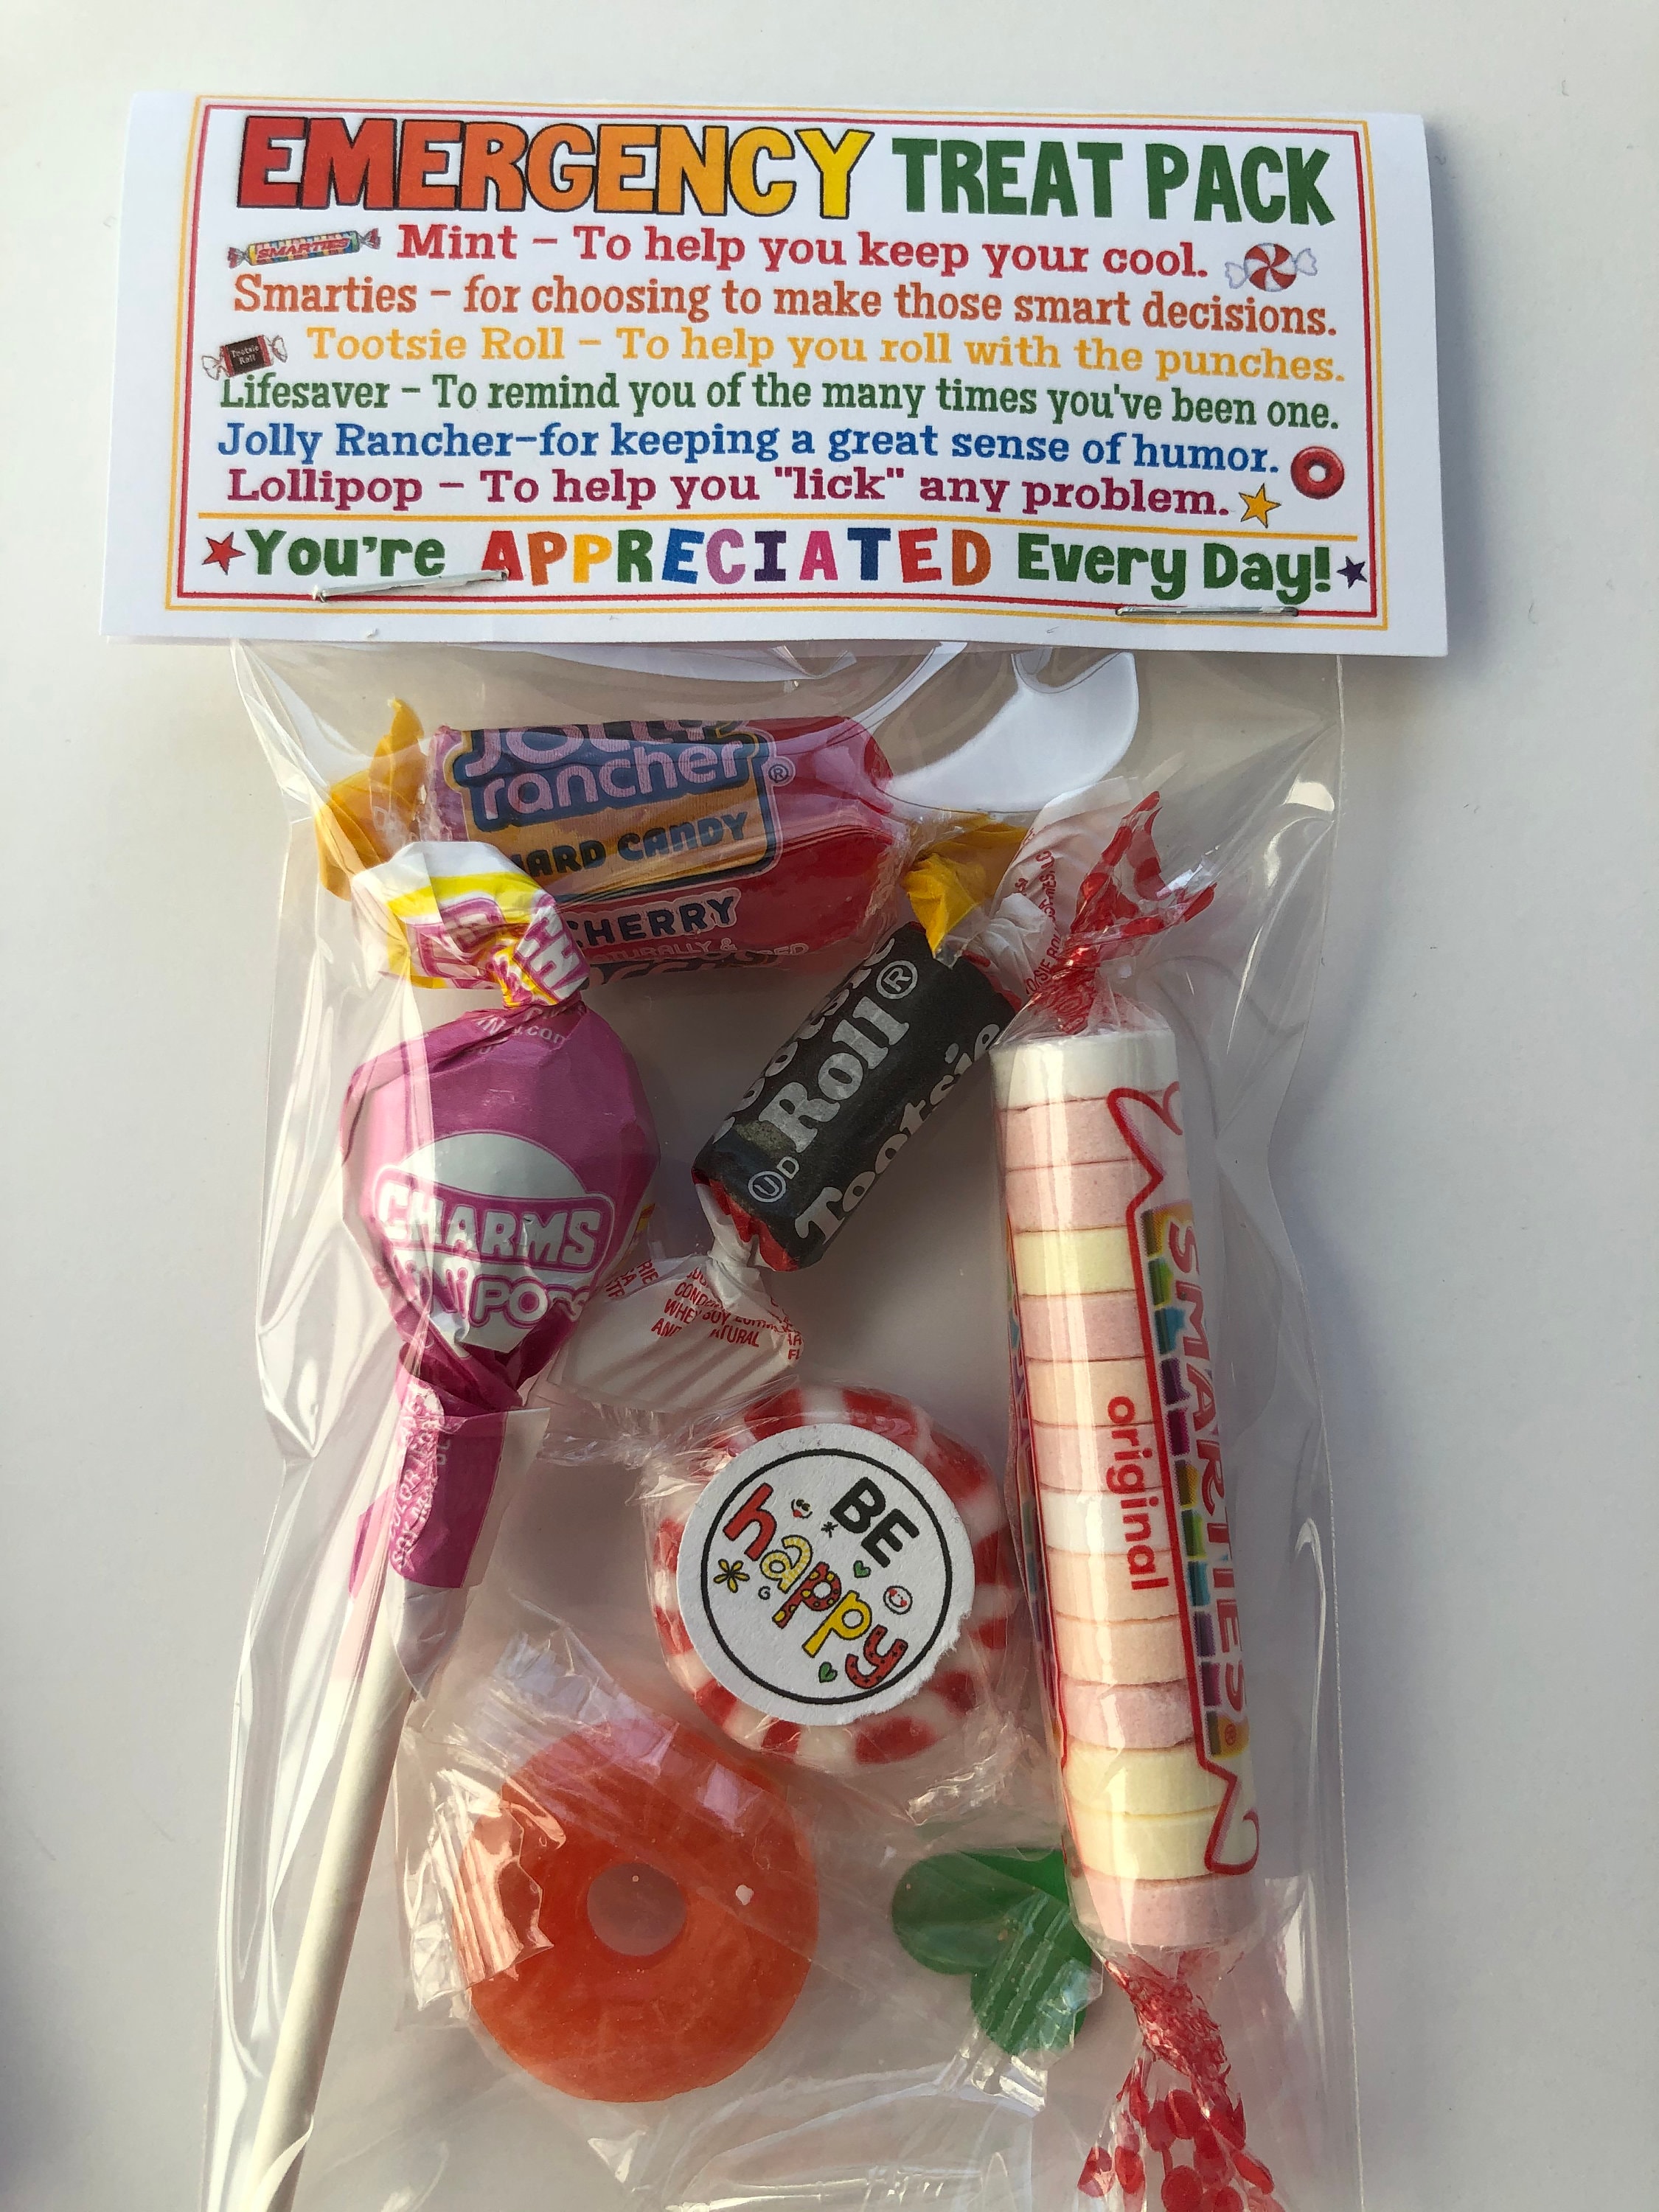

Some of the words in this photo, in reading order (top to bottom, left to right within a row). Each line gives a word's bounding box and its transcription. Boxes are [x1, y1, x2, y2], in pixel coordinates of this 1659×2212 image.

[236, 116, 875, 219] EMERGENCY
[893, 139, 1123, 218] TREAT
[1146, 144, 1335, 225] PACK
[257, 237, 350, 260] SMARTIES
[397, 224, 517, 259] Mint
[574, 226, 630, 260] To
[644, 226, 745, 270] help
[759, 238, 846, 271] you
[858, 232, 968, 276] keep
[982, 244, 1088, 278] your
[1103, 242, 1207, 276] cool.
[234, 274, 416, 313] Smarties
[465, 274, 520, 312] for
[532, 275, 710, 322] choosing
[722, 280, 760, 313] to
[774, 281, 880, 316] make
[894, 282, 1001, 319] those
[1015, 292, 1130, 325] smart
[1143, 291, 1336, 335] decisions.
[307, 327, 466, 360] Tootsie
[481, 327, 564, 359] Roll
[616, 327, 669, 359] To
[681, 327, 774, 367] help
[787, 337, 867, 368] you
[880, 332, 951, 363] roll
[964, 335, 1060, 367] with
[1074, 338, 1142, 371] the
[1156, 348, 1344, 380] punches.
[219, 372, 389, 409] Lifesaver
[432, 375, 478, 408] To
[488, 373, 617, 408] remind
[630, 383, 696, 416] you
[708, 372, 744, 406] of
[752, 372, 810, 406] the
[823, 383, 925, 417] many
[936, 378, 1036, 414] times
[1048, 384, 1161, 423] you've
[1172, 388, 1253, 424] been
[1268, 402, 1338, 428] one.
[218, 422, 322, 465] Jolly
[611, 422, 779, 463] keeping
[792, 431, 815, 453] a
[829, 425, 938, 462] great
[952, 434, 1068, 462] sense
[1083, 432, 1127, 465] of
[1132, 434, 1279, 473] humor.
[228, 469, 422, 511] Lollipop
[480, 470, 538, 502] To
[552, 469, 655, 509] help
[670, 476, 759, 509] you
[775, 467, 903, 499] "lick"
[920, 478, 1009, 512] any
[1022, 478, 1228, 515] problem.
[246, 530, 443, 576] You're
[480, 528, 991, 585] APPRECIATED
[1017, 535, 1186, 601] Every
[1204, 543, 1330, 605] Day!
[483, 740, 744, 821] rancher
[617, 811, 748, 862] CANDY
[758, 995, 910, 1153] Roll
[378, 1182, 602, 1266] CHARMS
[709, 1324, 760, 1348] ATURAL
[1106, 1394, 1169, 1591] original
[1169, 1220, 1246, 1713] SMARTIES
[830, 1476, 920, 1569] BE
[722, 1481, 909, 1690] happy
